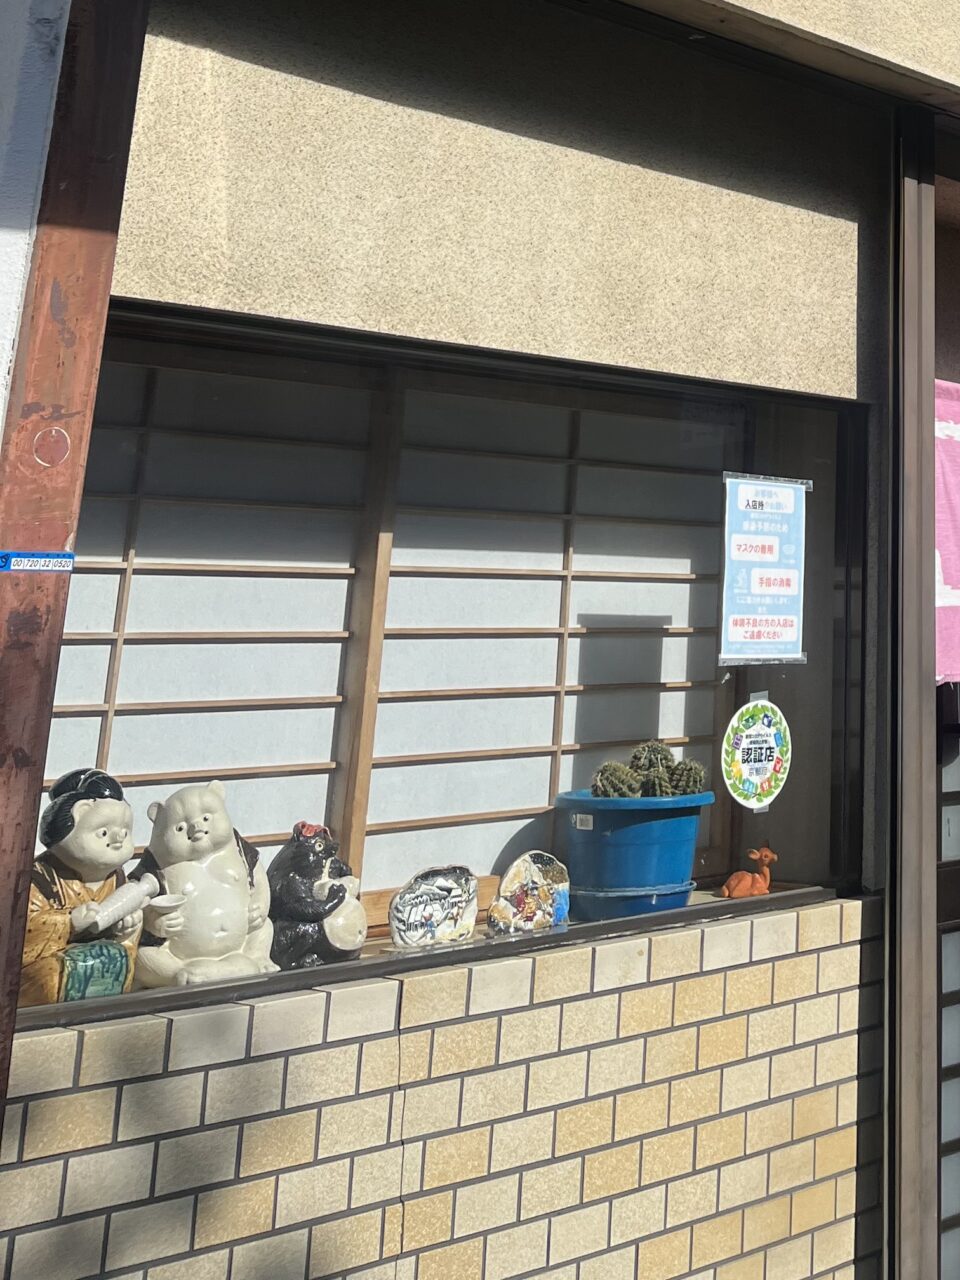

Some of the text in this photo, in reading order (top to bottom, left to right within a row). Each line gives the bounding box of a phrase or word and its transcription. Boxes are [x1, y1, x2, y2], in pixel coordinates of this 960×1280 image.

[736, 543, 774, 554] マスクの着用
[12, 559, 72, 568] 00 720 32 0520
[758, 576, 792, 588] 手指の消毒
[732, 617, 794, 629] 体調不良の方の入店は
[743, 630, 783, 640] ご遠慮ください
[741, 746, 775, 764] 認証店
